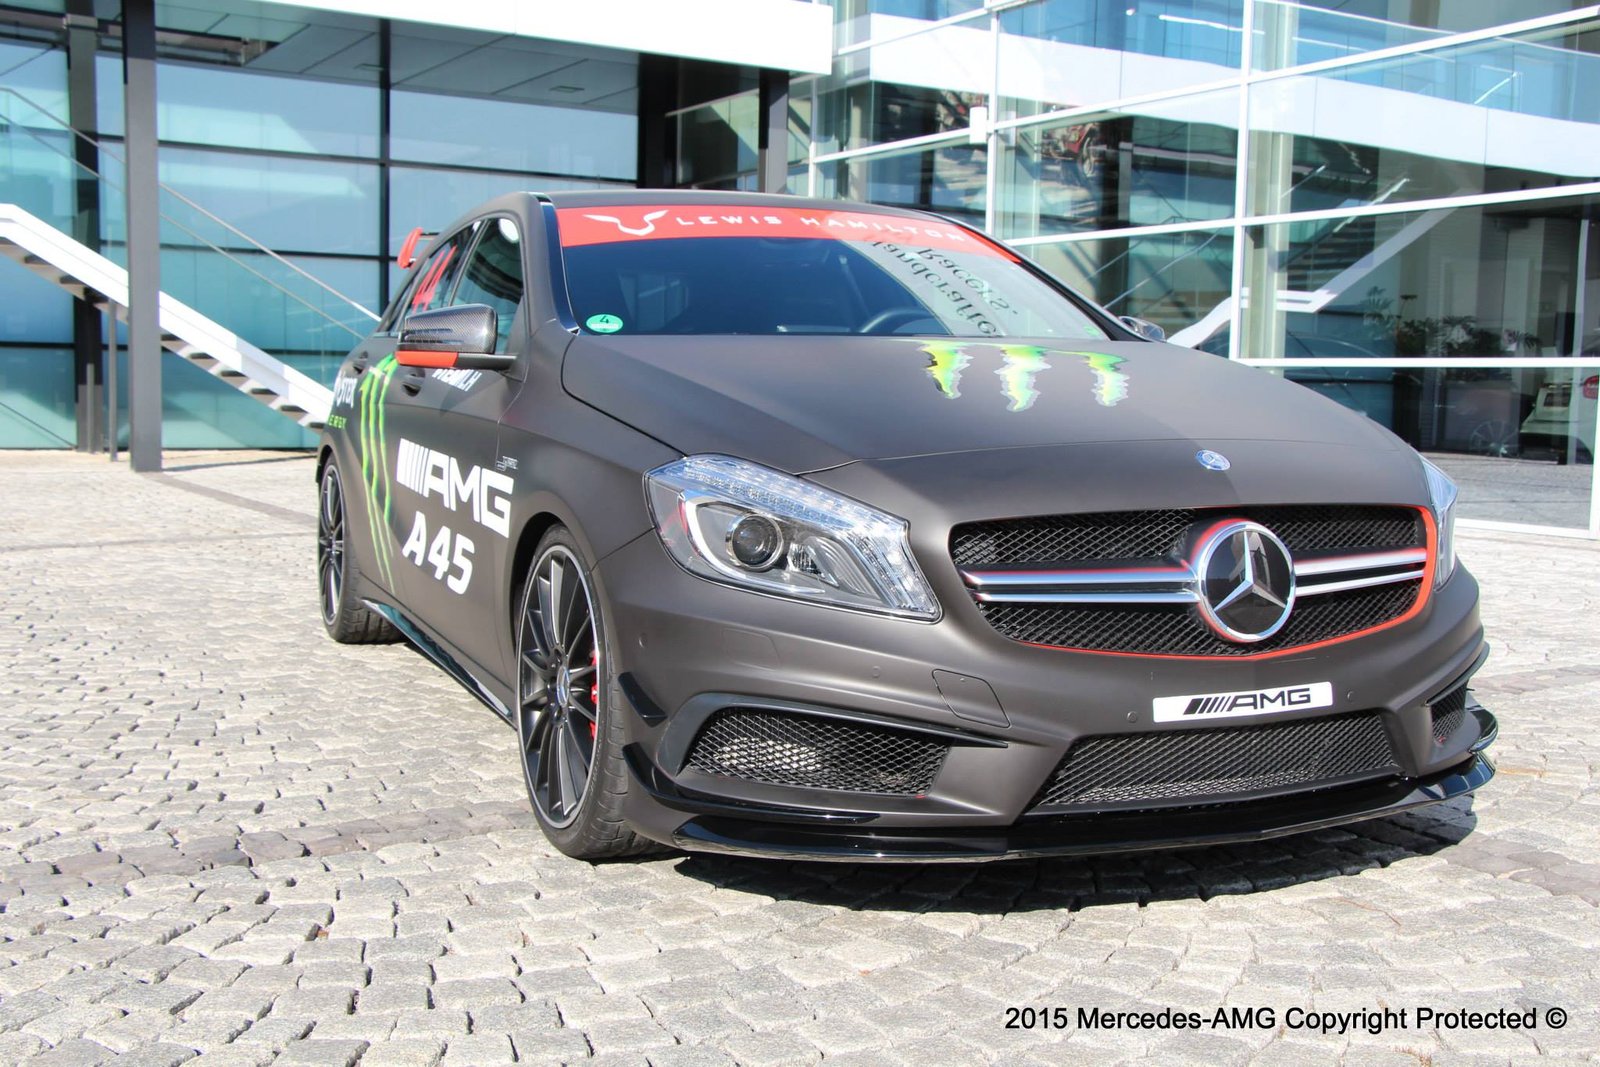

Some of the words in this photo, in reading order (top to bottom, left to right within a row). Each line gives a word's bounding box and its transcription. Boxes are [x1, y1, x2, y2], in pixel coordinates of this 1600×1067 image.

[675, 215, 783, 226] LEWIS
[799, 216, 966, 242] HAMILTON
[599, 315, 610, 325] 4
